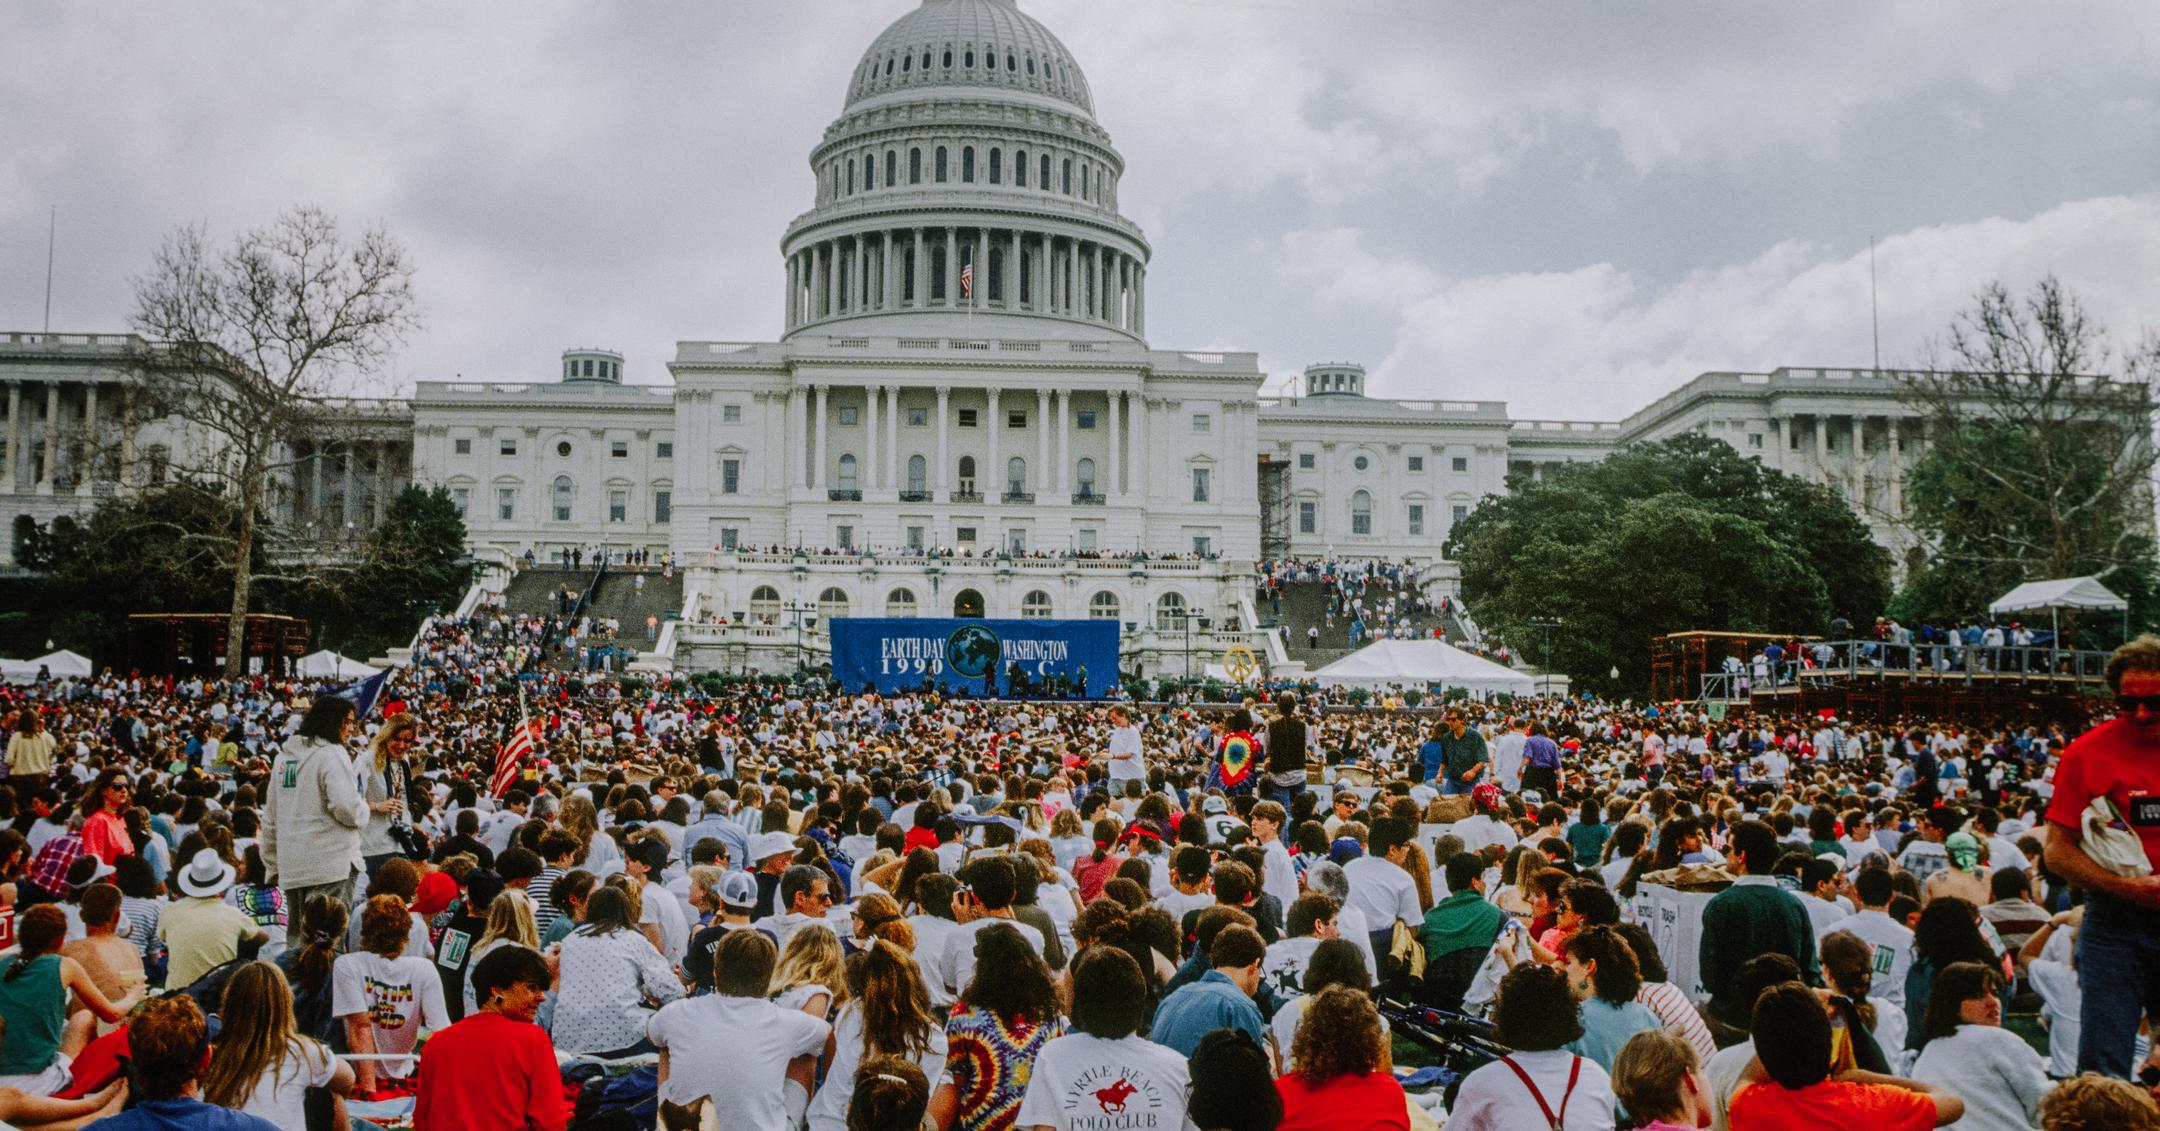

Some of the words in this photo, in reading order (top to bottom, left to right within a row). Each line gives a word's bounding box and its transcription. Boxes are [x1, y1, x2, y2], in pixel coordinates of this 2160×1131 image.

[881, 638, 920, 658] EARTH
[923, 638, 946, 659] DAY
[1003, 639, 1068, 660] WASHINGTON
[881, 658, 943, 675] 1990
[1064, 1065, 1112, 1110] MYRTLE
[1119, 1066, 1162, 1108] BEACH
[1070, 1115, 1111, 1131] POLO
[1115, 1113, 1157, 1129] CLUB
